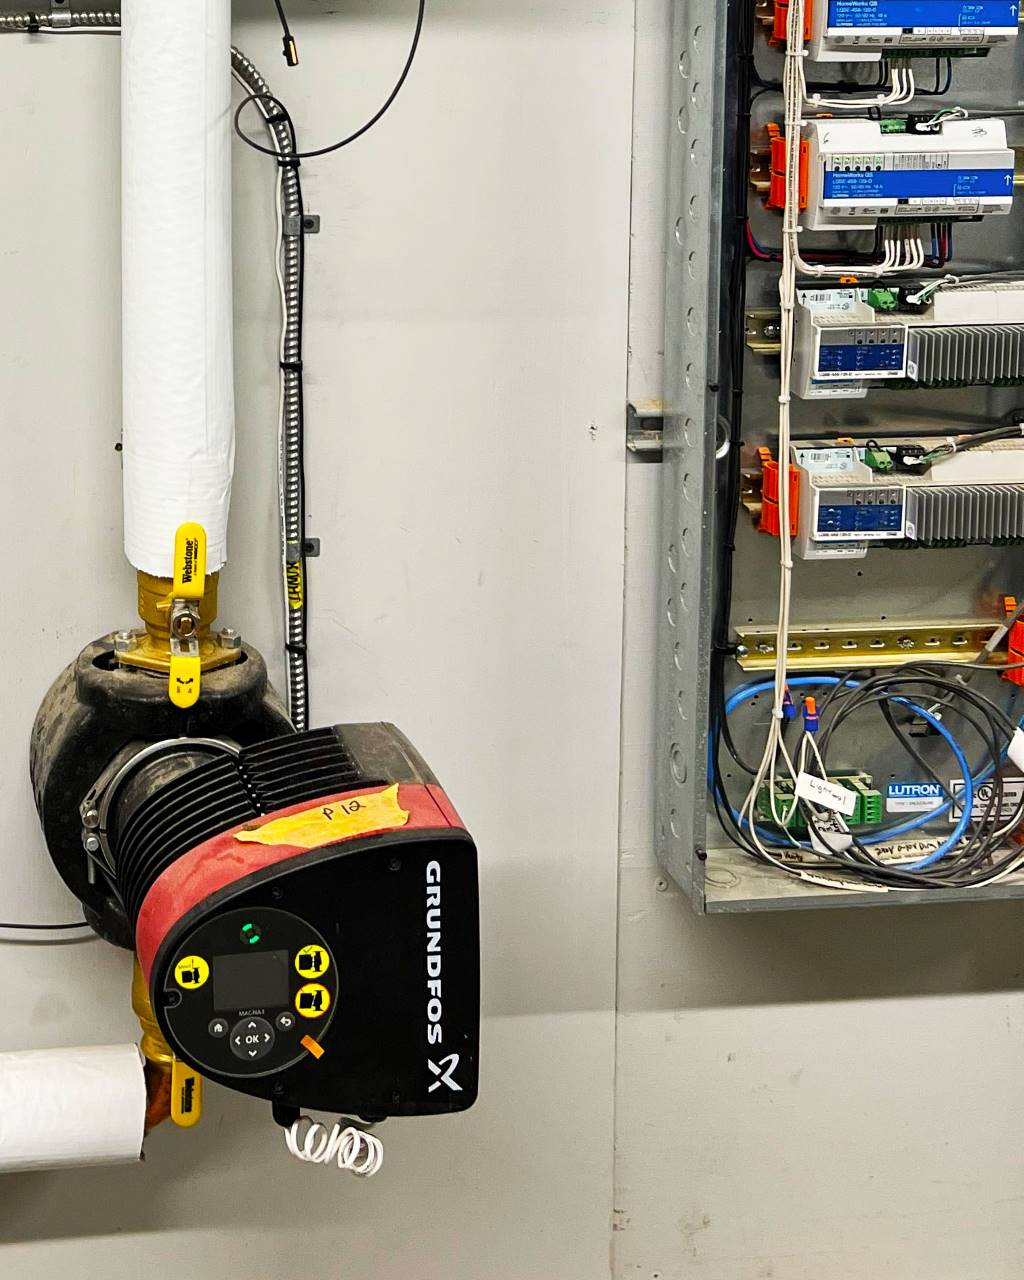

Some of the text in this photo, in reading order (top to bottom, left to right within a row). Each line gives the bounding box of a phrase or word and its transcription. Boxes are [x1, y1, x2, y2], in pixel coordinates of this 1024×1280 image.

[182, 540, 193, 584] Webstone
[888, 784, 939, 795] LUTRON
[322, 799, 367, 821] P 12
[425, 859, 443, 1046] GRUNDFOS
[245, 1035, 259, 1044] OK
